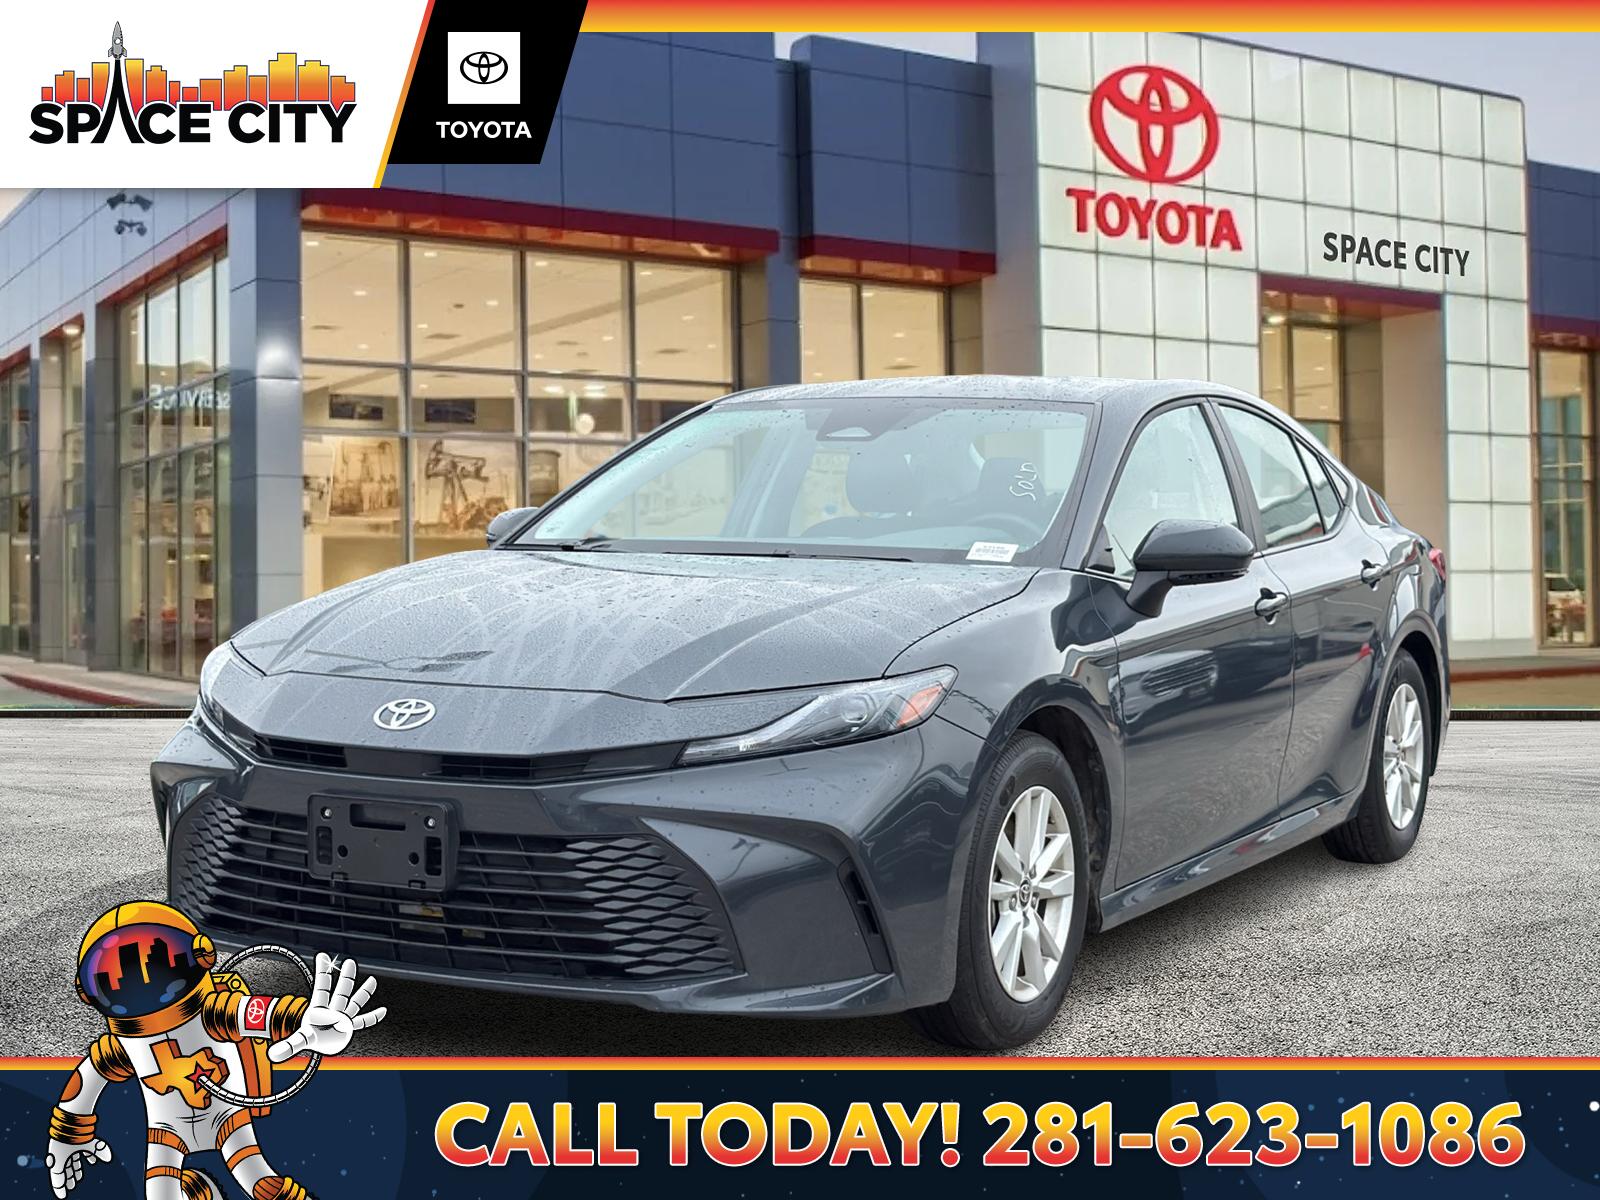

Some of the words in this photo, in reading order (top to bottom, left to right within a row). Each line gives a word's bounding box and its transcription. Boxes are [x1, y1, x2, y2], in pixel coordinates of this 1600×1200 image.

[1066, 187, 1242, 251] TOYOTA
[1323, 232, 1407, 270] SPACE
[1415, 243, 1470, 276] CITY
